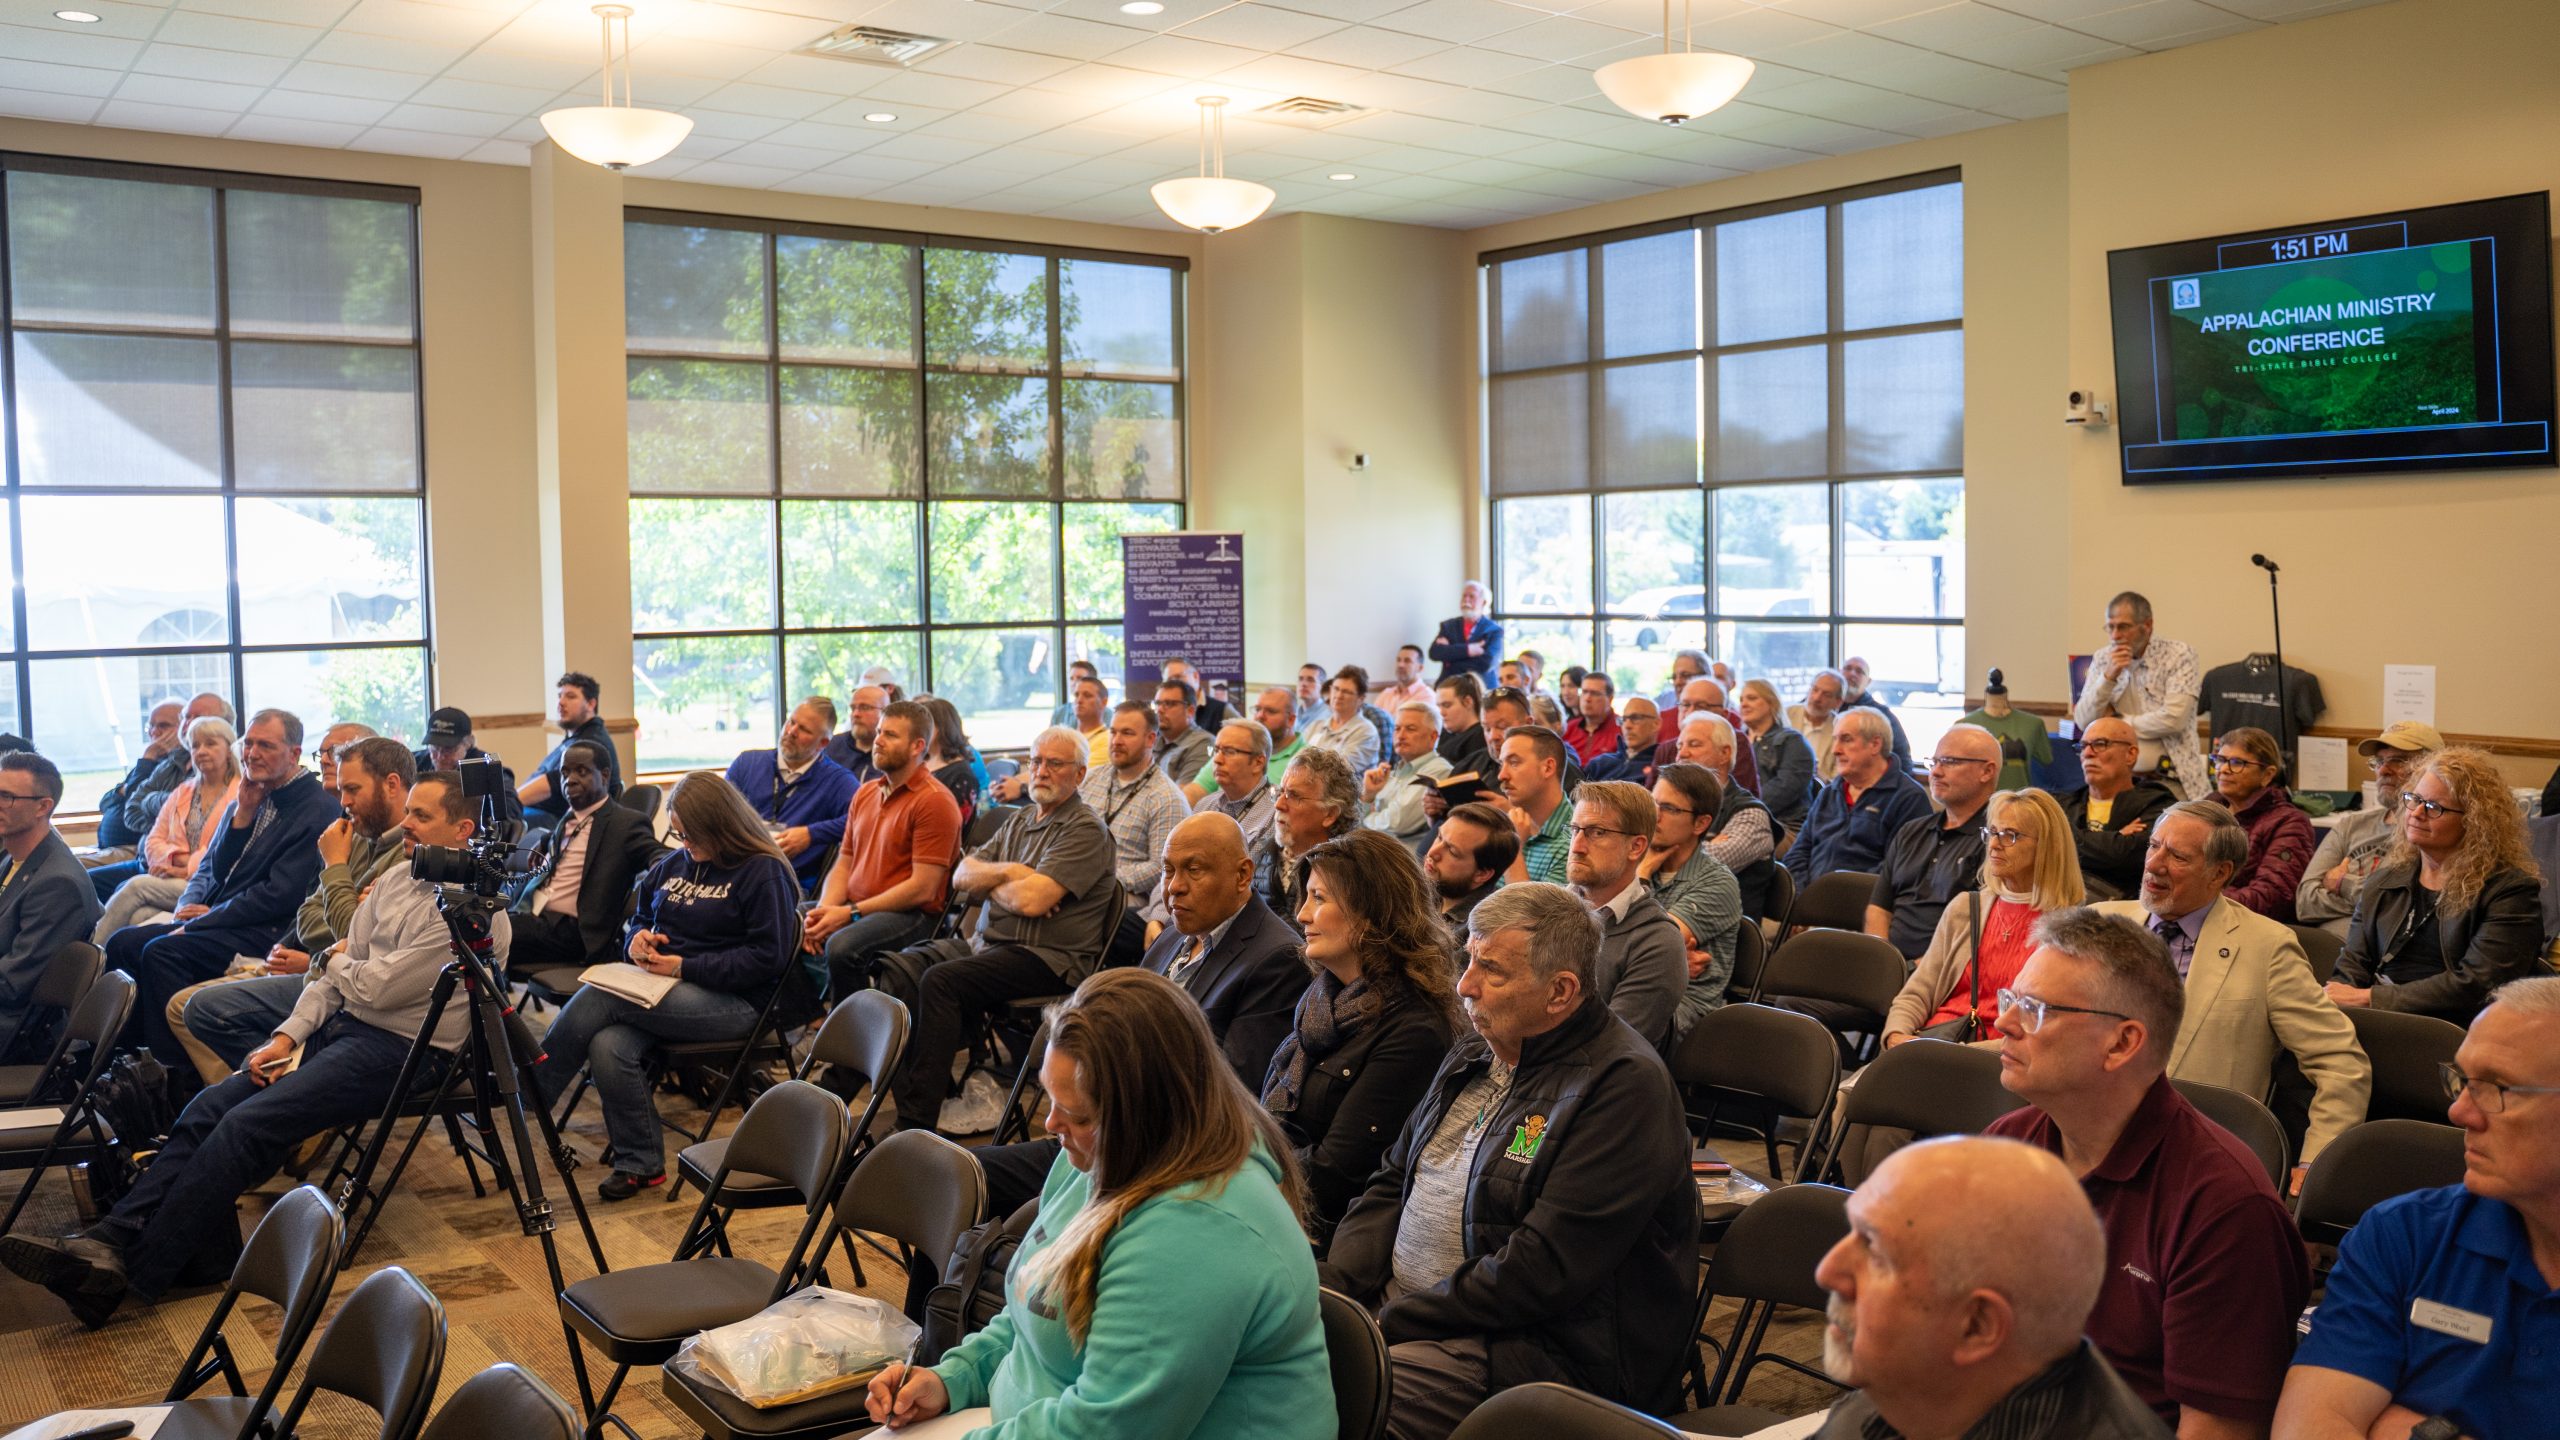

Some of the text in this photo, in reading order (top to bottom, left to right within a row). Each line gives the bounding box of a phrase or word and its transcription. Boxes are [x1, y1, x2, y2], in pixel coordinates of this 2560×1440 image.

[2270, 232, 2348, 260] 1:51 PM
[2200, 292, 2436, 333] APPALACHIAN MINISTRY
[2248, 327, 2385, 356] CONFERENCE
[2234, 352, 2398, 373] TRI-STATE BIBLE COLLEGE
[1168, 600, 1239, 608] SCHOLARSHIP
